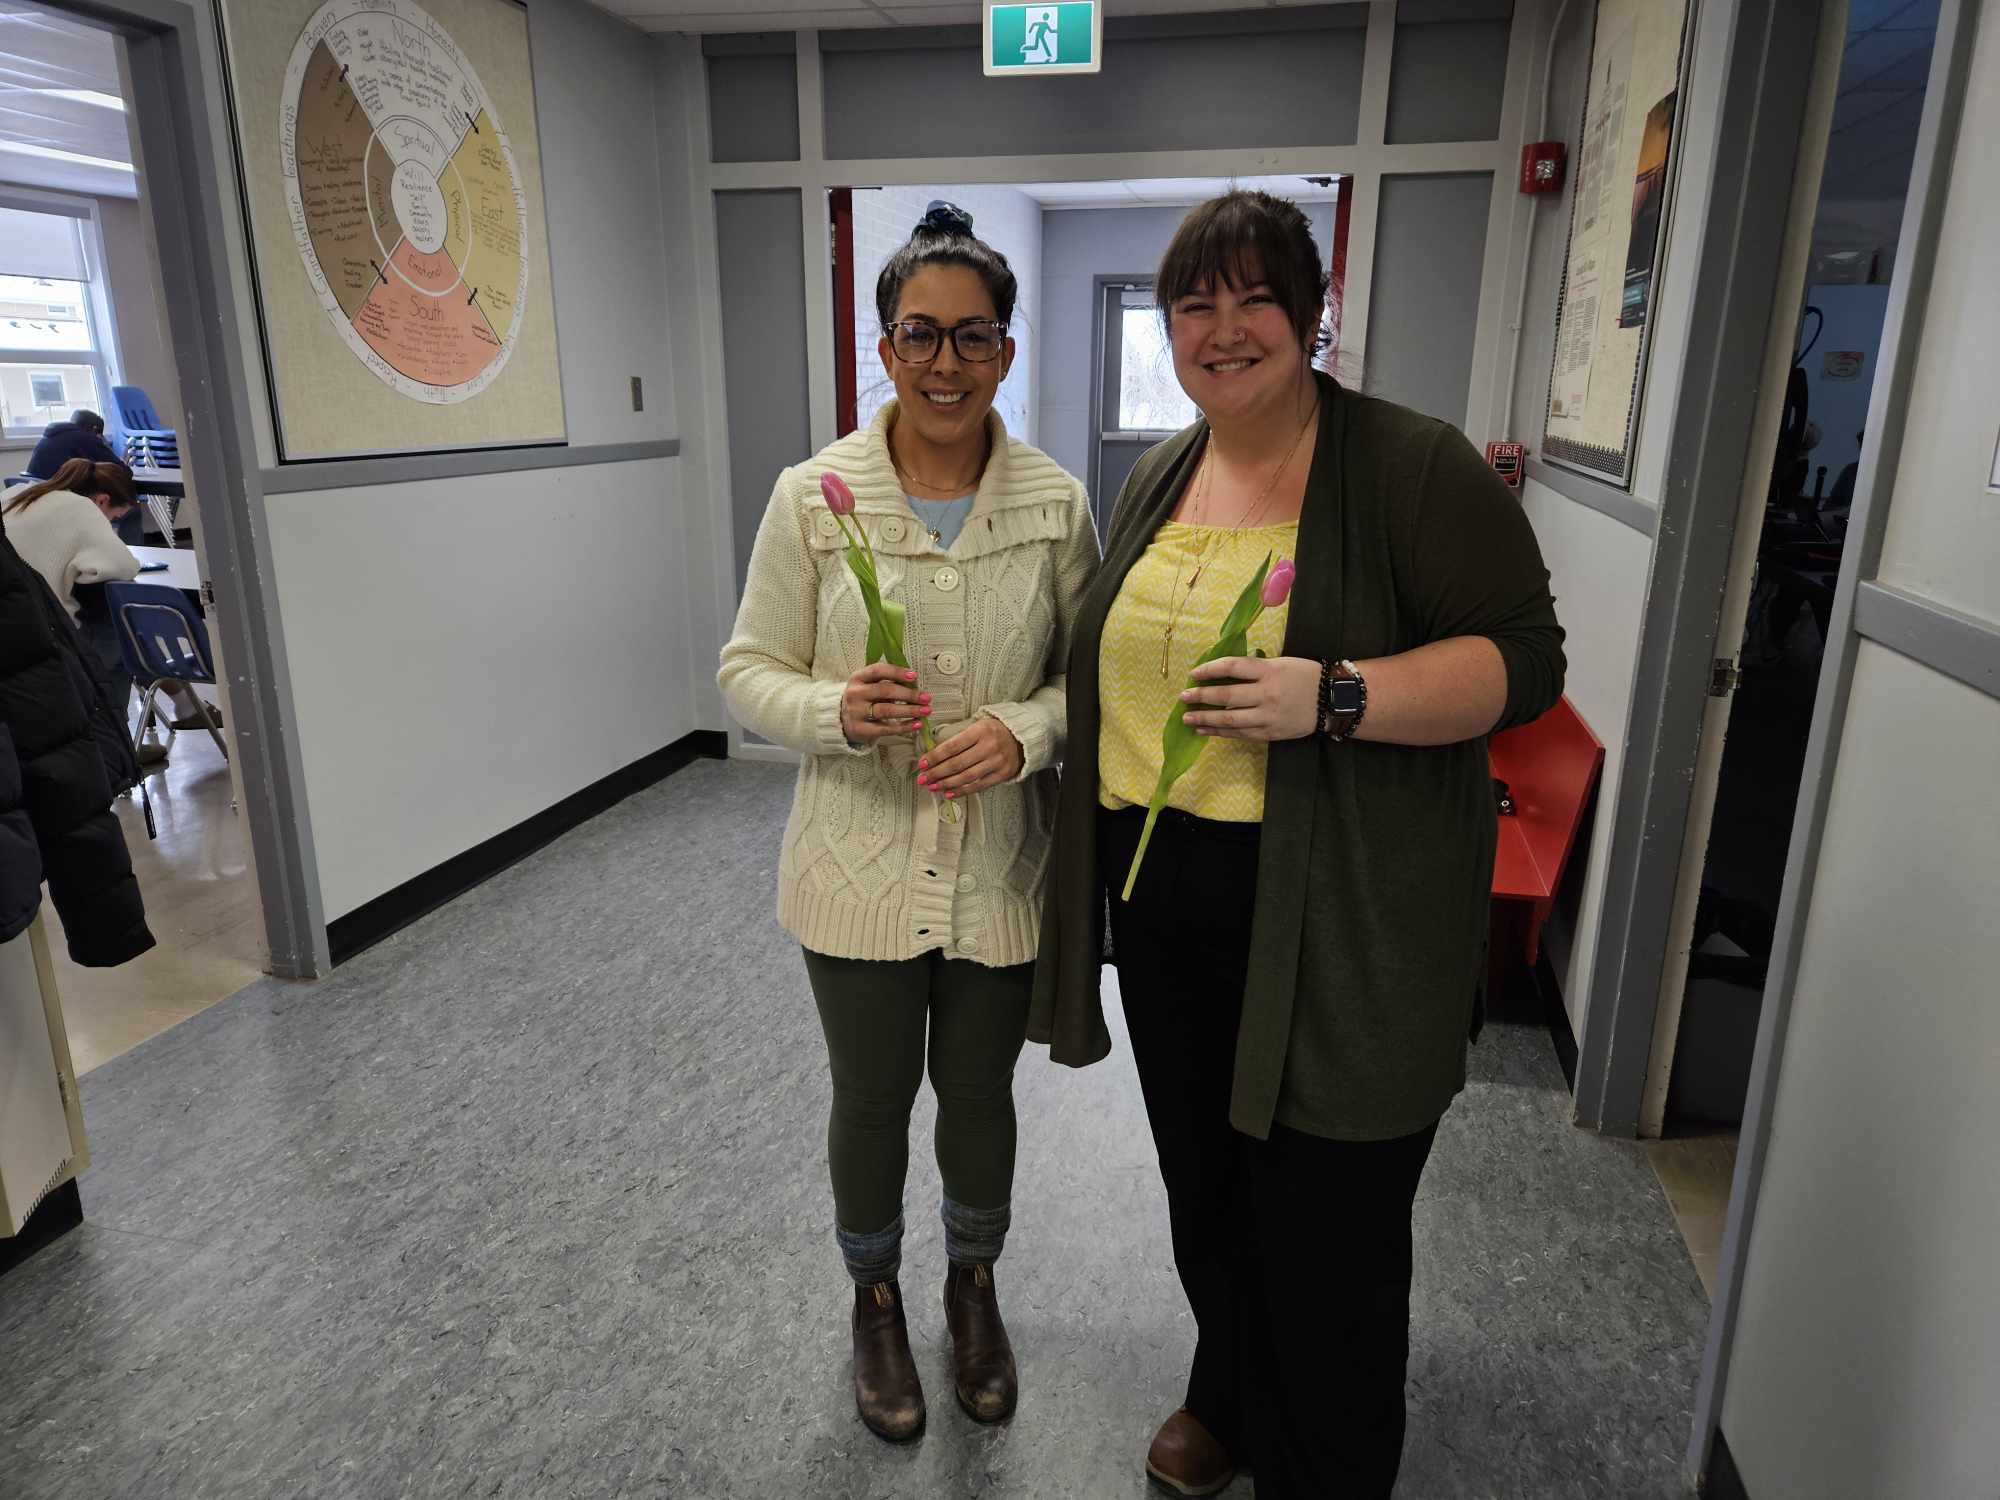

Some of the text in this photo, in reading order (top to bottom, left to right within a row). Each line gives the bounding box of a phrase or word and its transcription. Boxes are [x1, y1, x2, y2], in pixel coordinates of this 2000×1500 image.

[391, 19, 432, 60] North
[281, 104, 296, 178] Teachings
[481, 196, 505, 222] East
[409, 295, 444, 321] South
[1494, 445, 1521, 456] FIRE
